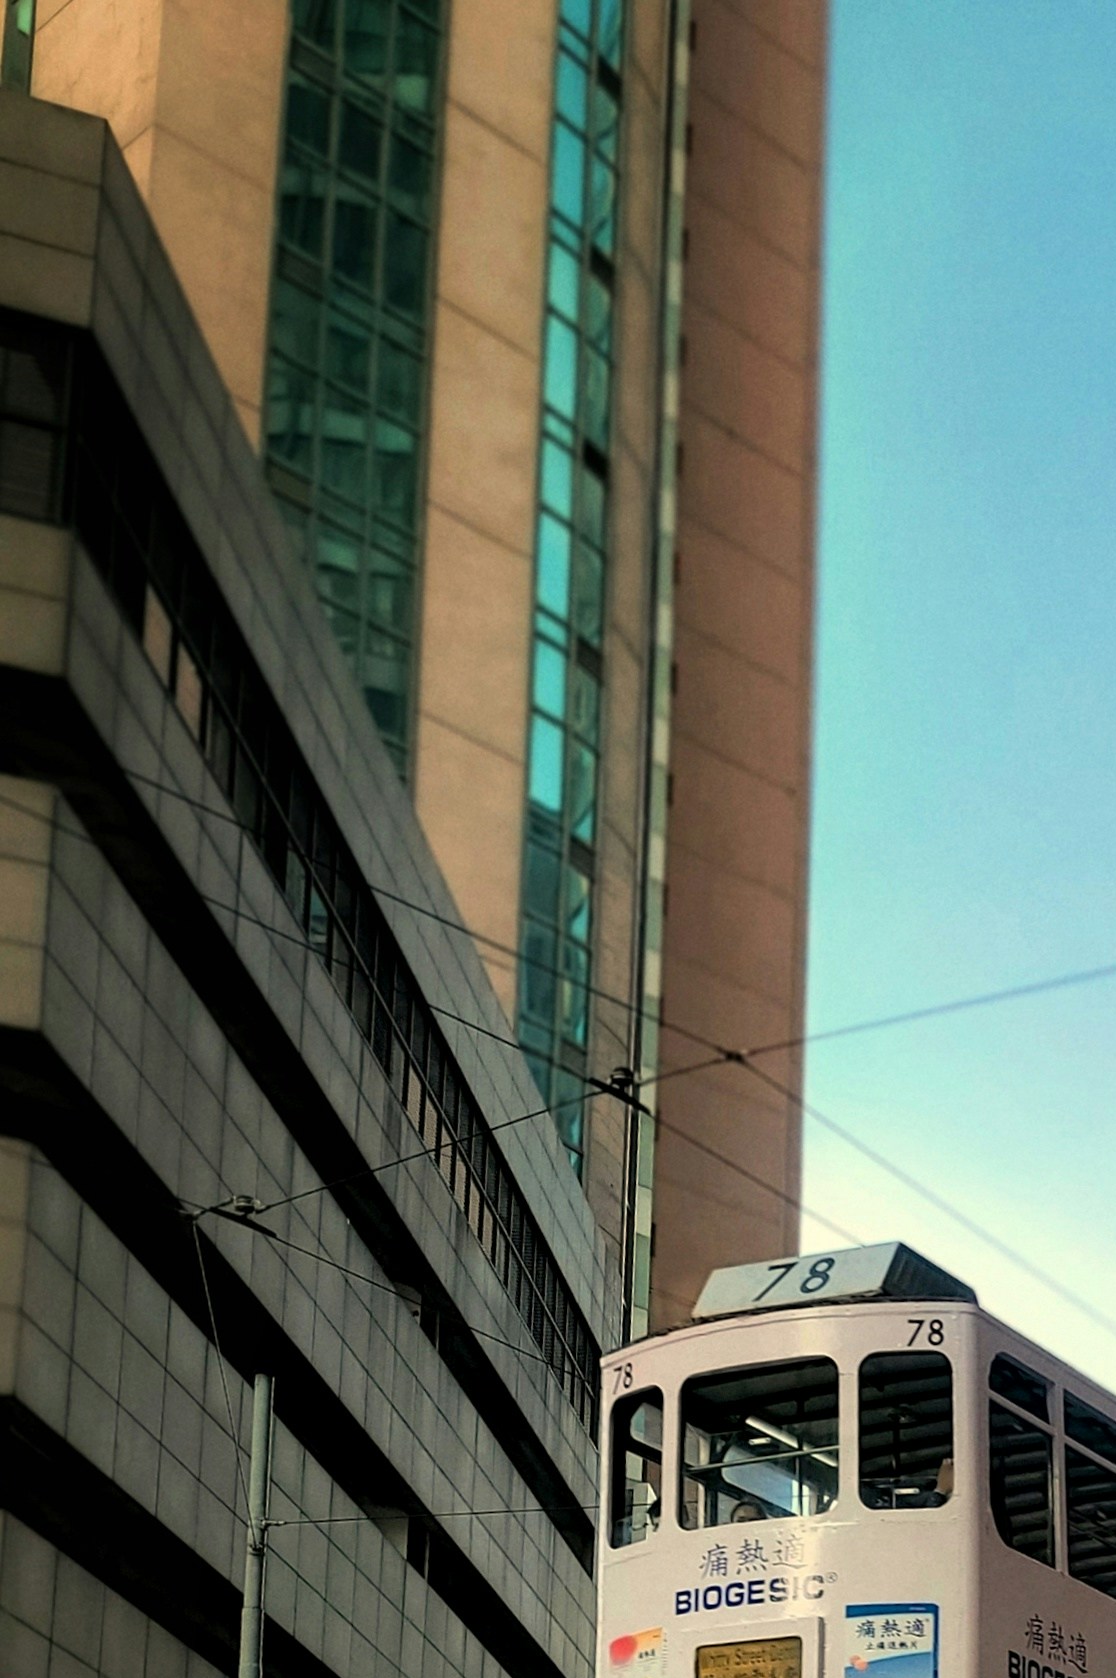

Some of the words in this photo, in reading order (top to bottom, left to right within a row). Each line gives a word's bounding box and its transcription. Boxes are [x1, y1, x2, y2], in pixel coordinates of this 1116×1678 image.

[753, 1257, 836, 1302] 78
[906, 1319, 945, 1347] 78
[612, 1361, 634, 1395] 78
[698, 1535, 810, 1579] 痛熱適
[675, 1575, 825, 1616] BIOGESIC
[855, 1618, 927, 1638] 痛熱適
[1024, 1613, 1089, 1673] 痛熱適
